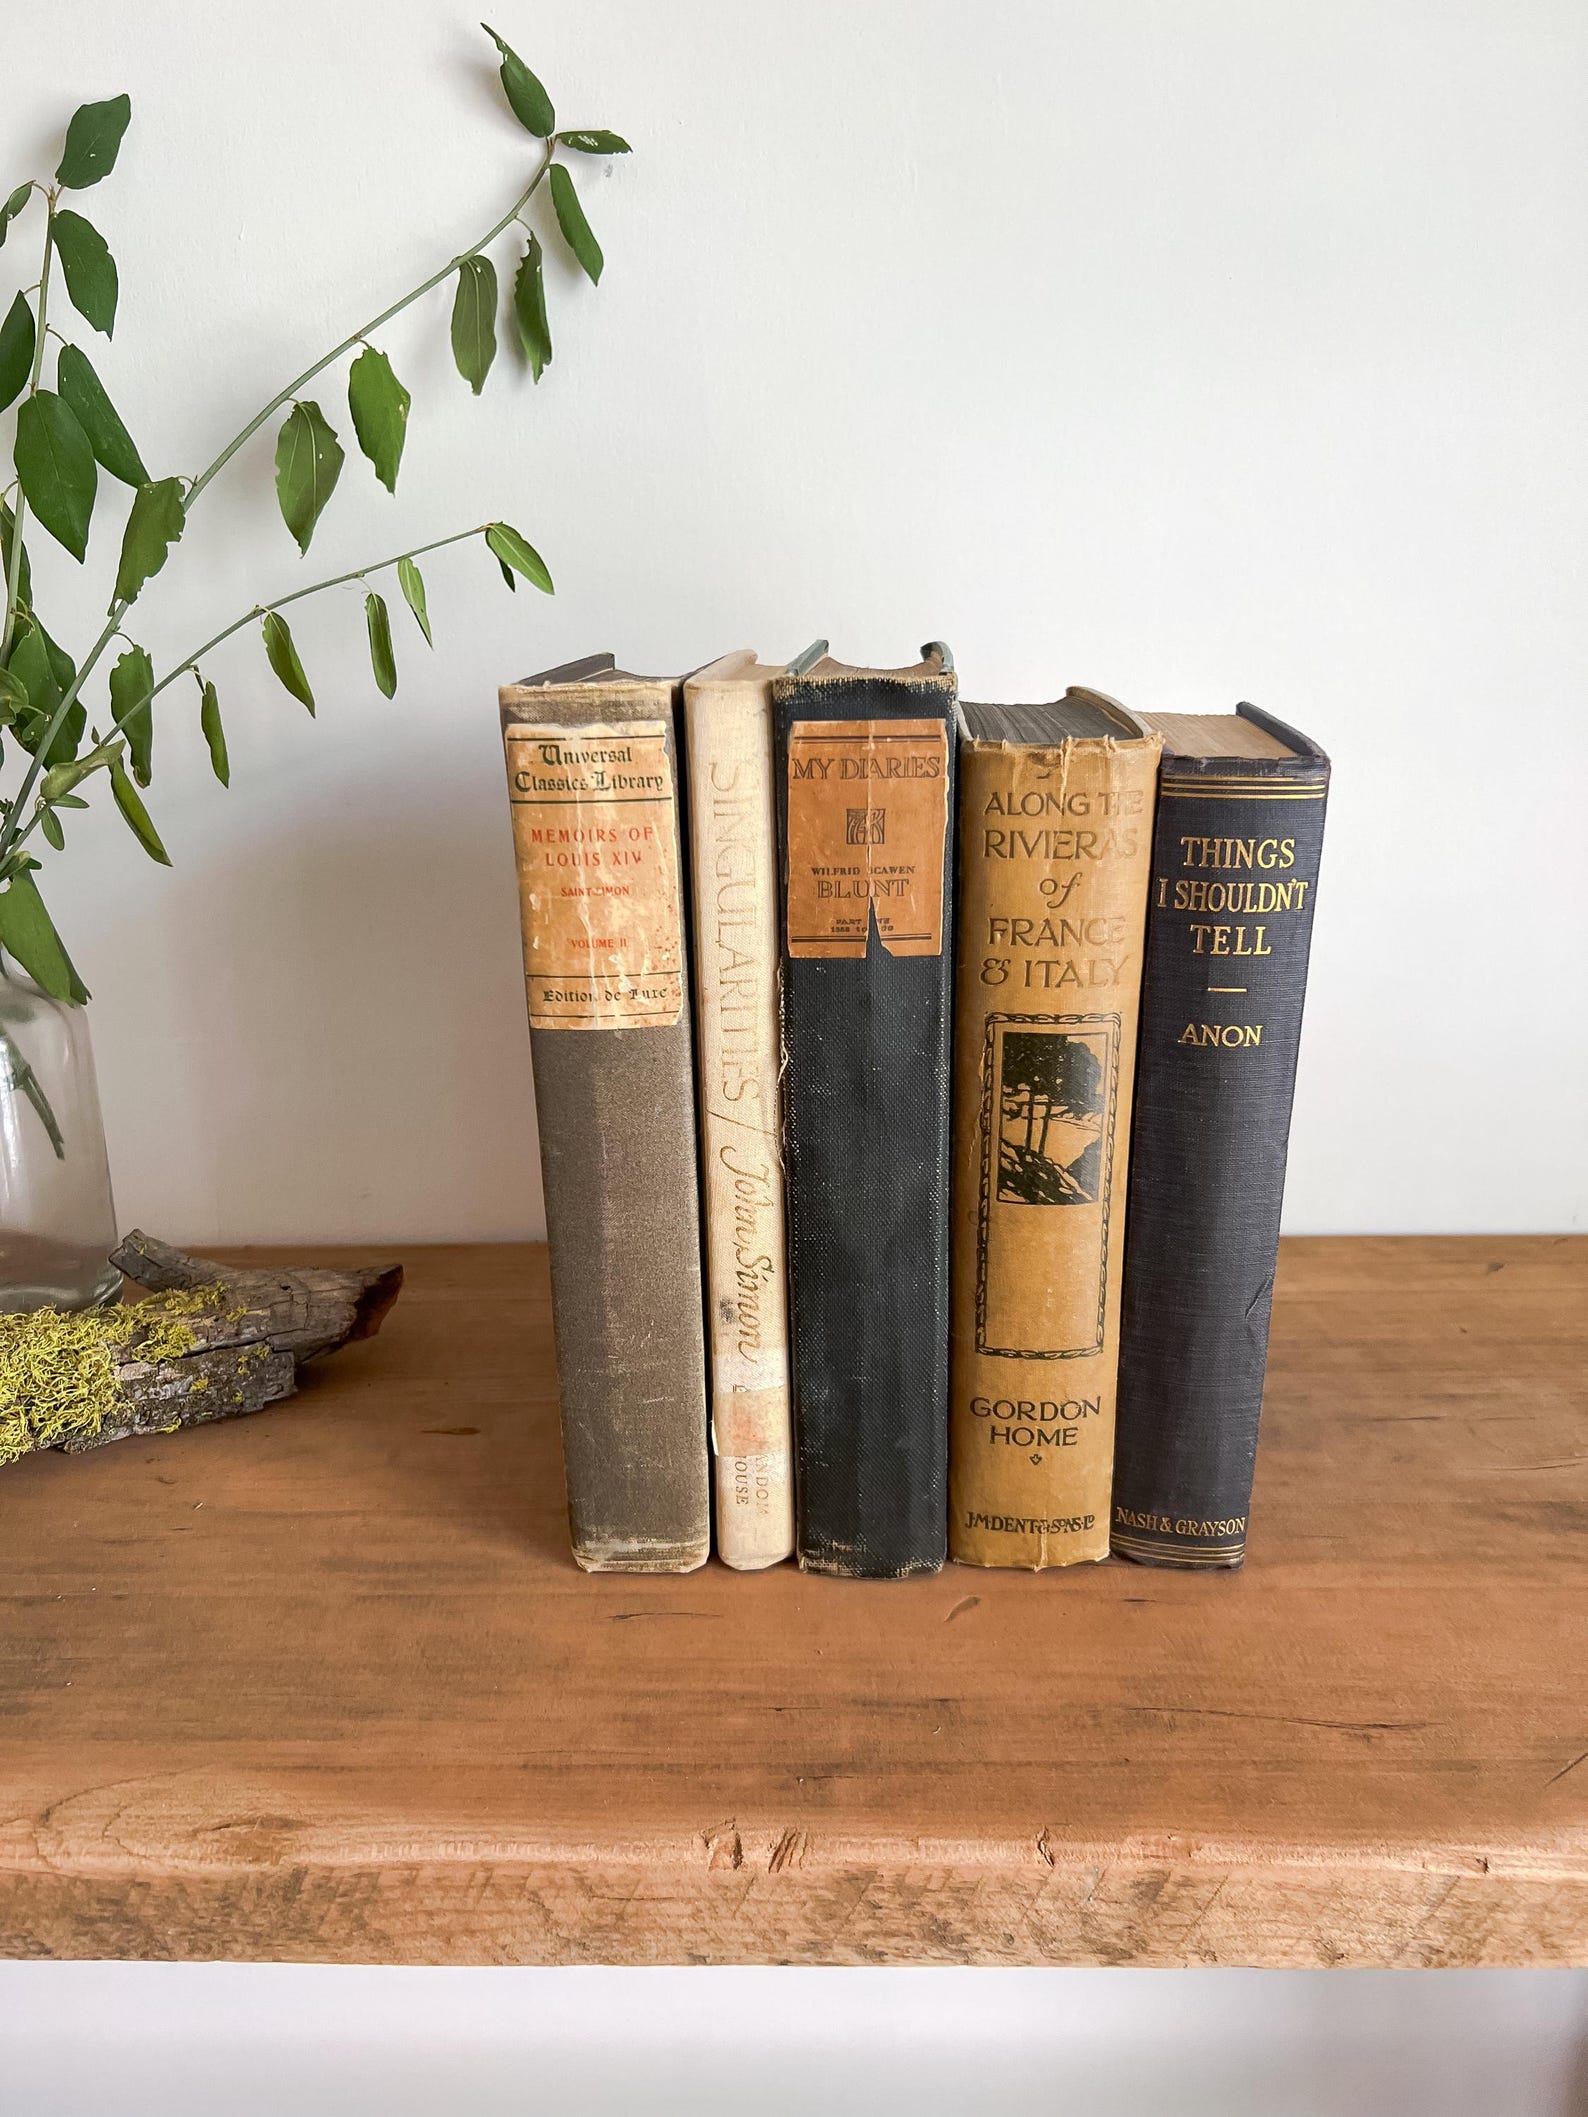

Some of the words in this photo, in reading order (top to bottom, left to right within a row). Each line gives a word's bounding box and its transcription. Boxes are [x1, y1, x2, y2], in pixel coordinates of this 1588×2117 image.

[538, 744, 633, 766] Universal
[792, 757, 835, 780] MY
[840, 756, 940, 780] DIARIES
[515, 771, 589, 792] Classics
[591, 770, 664, 792] Library
[984, 790, 1091, 817] ALONG
[531, 828, 617, 843] MEMOIRS
[628, 826, 654, 842] OF
[982, 828, 1138, 861] RIVIERAS
[546, 852, 601, 867] LOUIS
[612, 850, 643, 866] XIV
[1180, 836, 1296, 870] THINGS
[811, 866, 861, 876] WILFRID
[817, 878, 910, 899] BLUNT
[1039, 871, 1083, 909] of
[1157, 877, 1169, 908] I
[1174, 877, 1309, 914] SHOULDN'T
[571, 938, 614, 949] VOLUME
[619, 937, 629, 948] II
[708, 762, 760, 1102] SINGULARITIES
[987, 916, 1127, 948] FRANCE
[1190, 924, 1272, 956] TELL
[979, 956, 1012, 986] &
[1023, 952, 1131, 989] ITALY
[604, 989, 621, 1001] de
[1177, 1023, 1264, 1048] ANON
[719, 1145, 774, 1243] John
[732, 1240, 775, 1364] Simon
[969, 1396, 1102, 1422] GORDON
[989, 1425, 1079, 1447] HOME
[1115, 1506, 1157, 1532] NASH
[1159, 1516, 1173, 1534] &
[1175, 1516, 1247, 1537] GRAYSON
